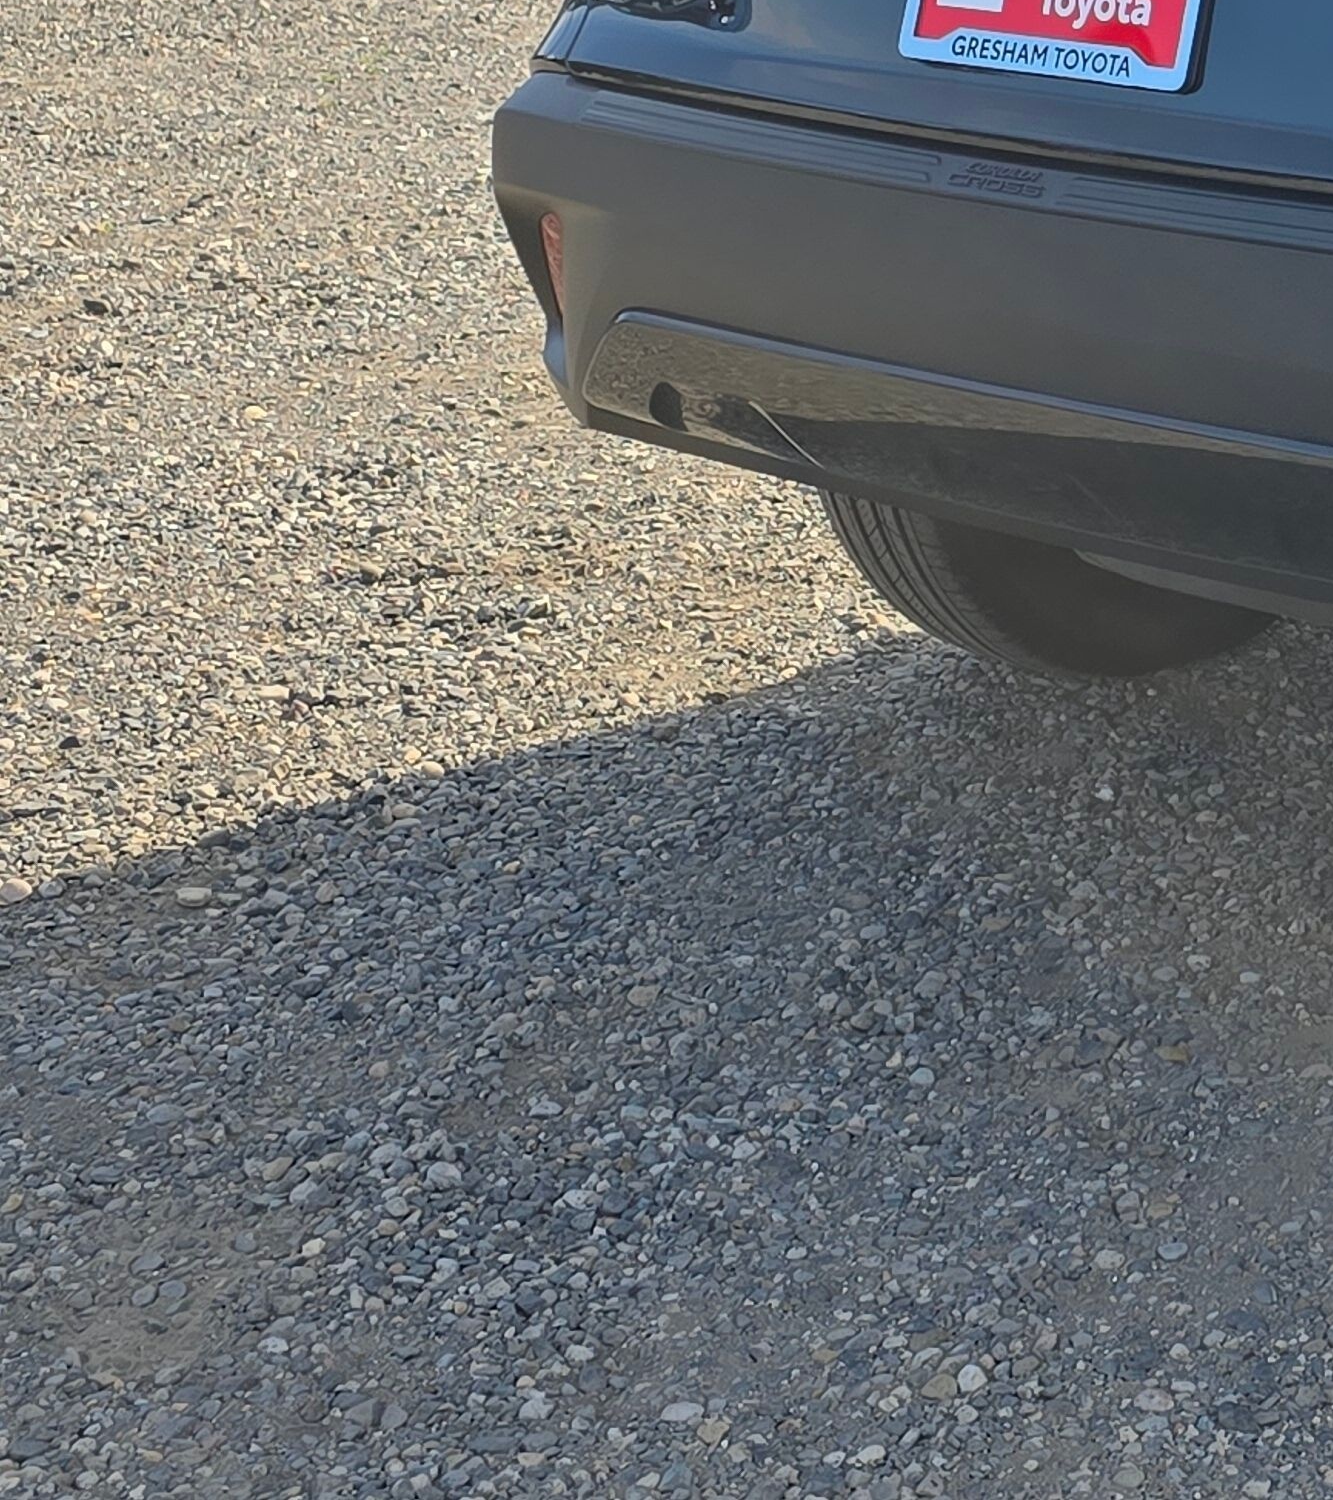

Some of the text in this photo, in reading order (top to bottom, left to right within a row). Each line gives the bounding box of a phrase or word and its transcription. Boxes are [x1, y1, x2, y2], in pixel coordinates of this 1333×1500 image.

[951, 35, 1131, 78] GRESHAM TOYOTA
[947, 174, 1046, 199] CROSS
